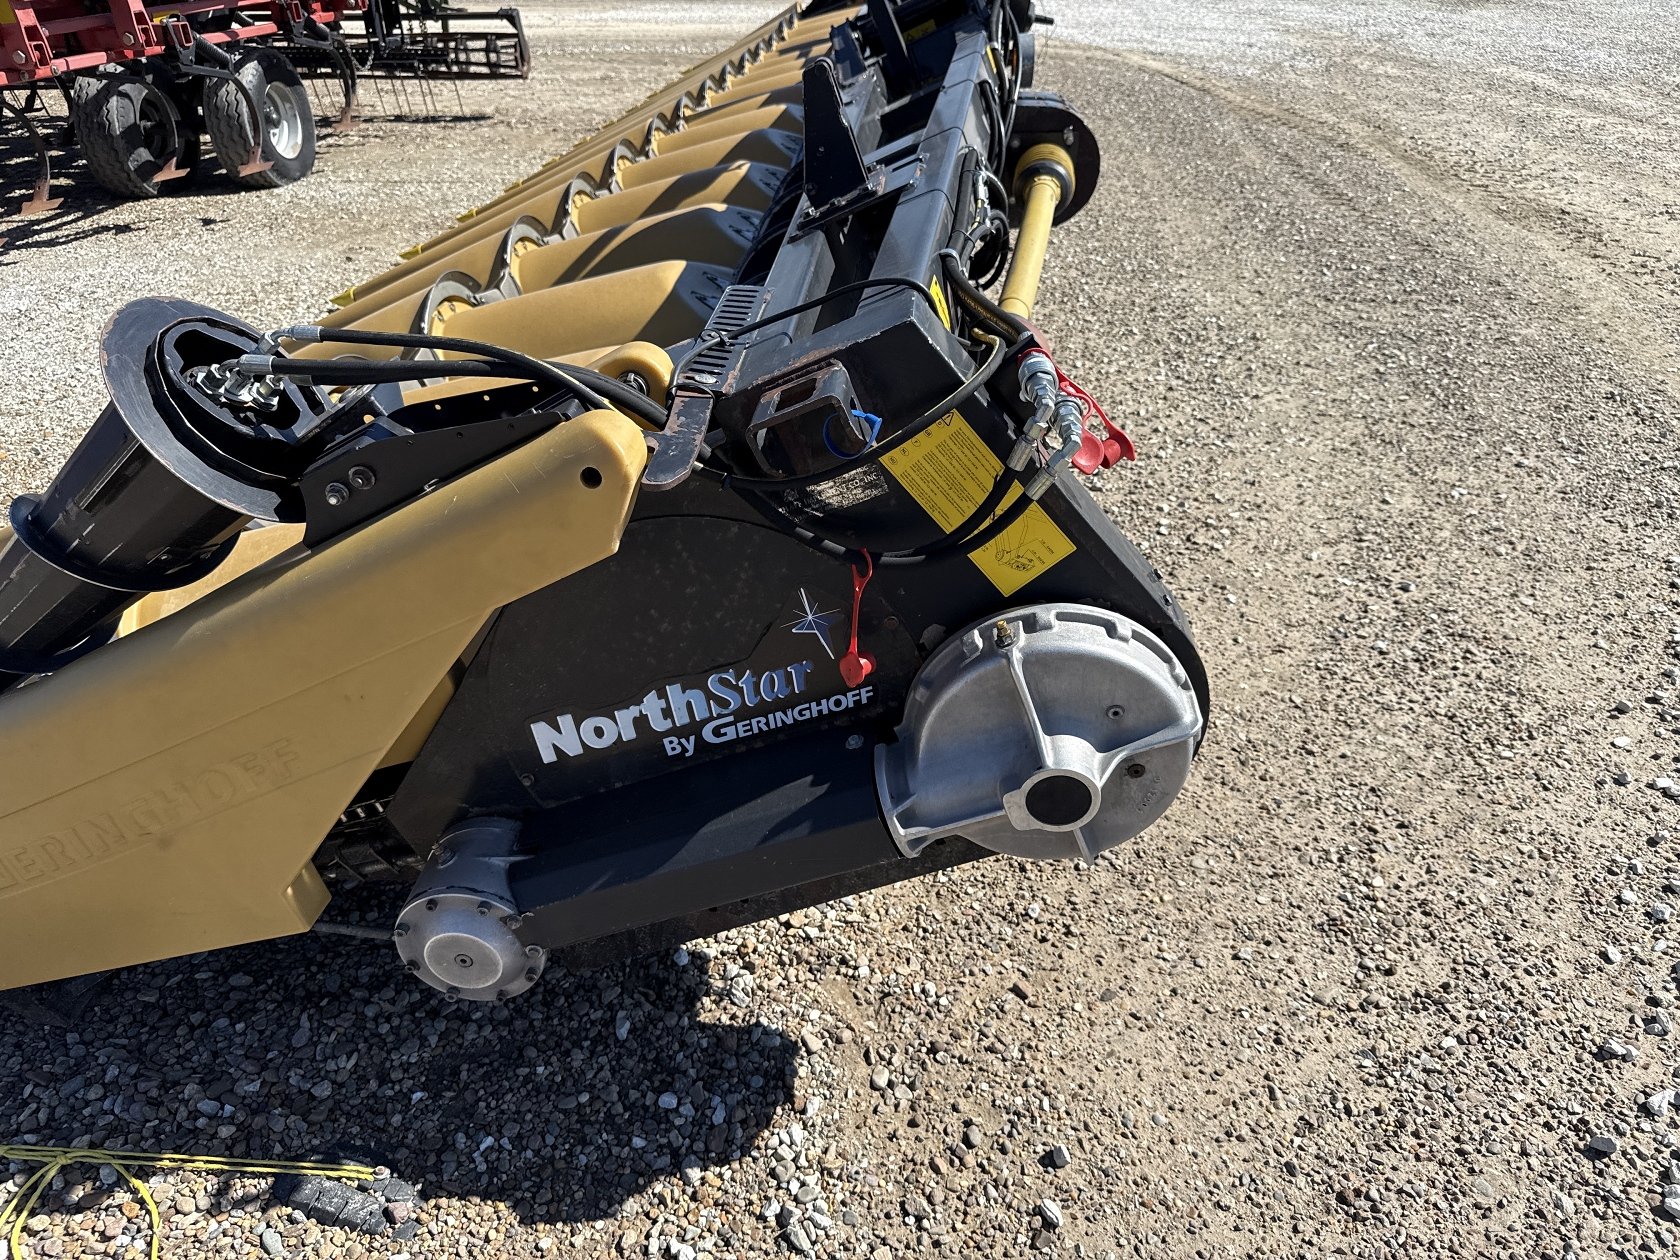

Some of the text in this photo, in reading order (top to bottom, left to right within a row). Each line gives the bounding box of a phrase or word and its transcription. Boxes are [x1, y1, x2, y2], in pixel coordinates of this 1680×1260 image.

[530, 660, 815, 765] NorthStar
[663, 686, 875, 758] By GERINGHOFF
